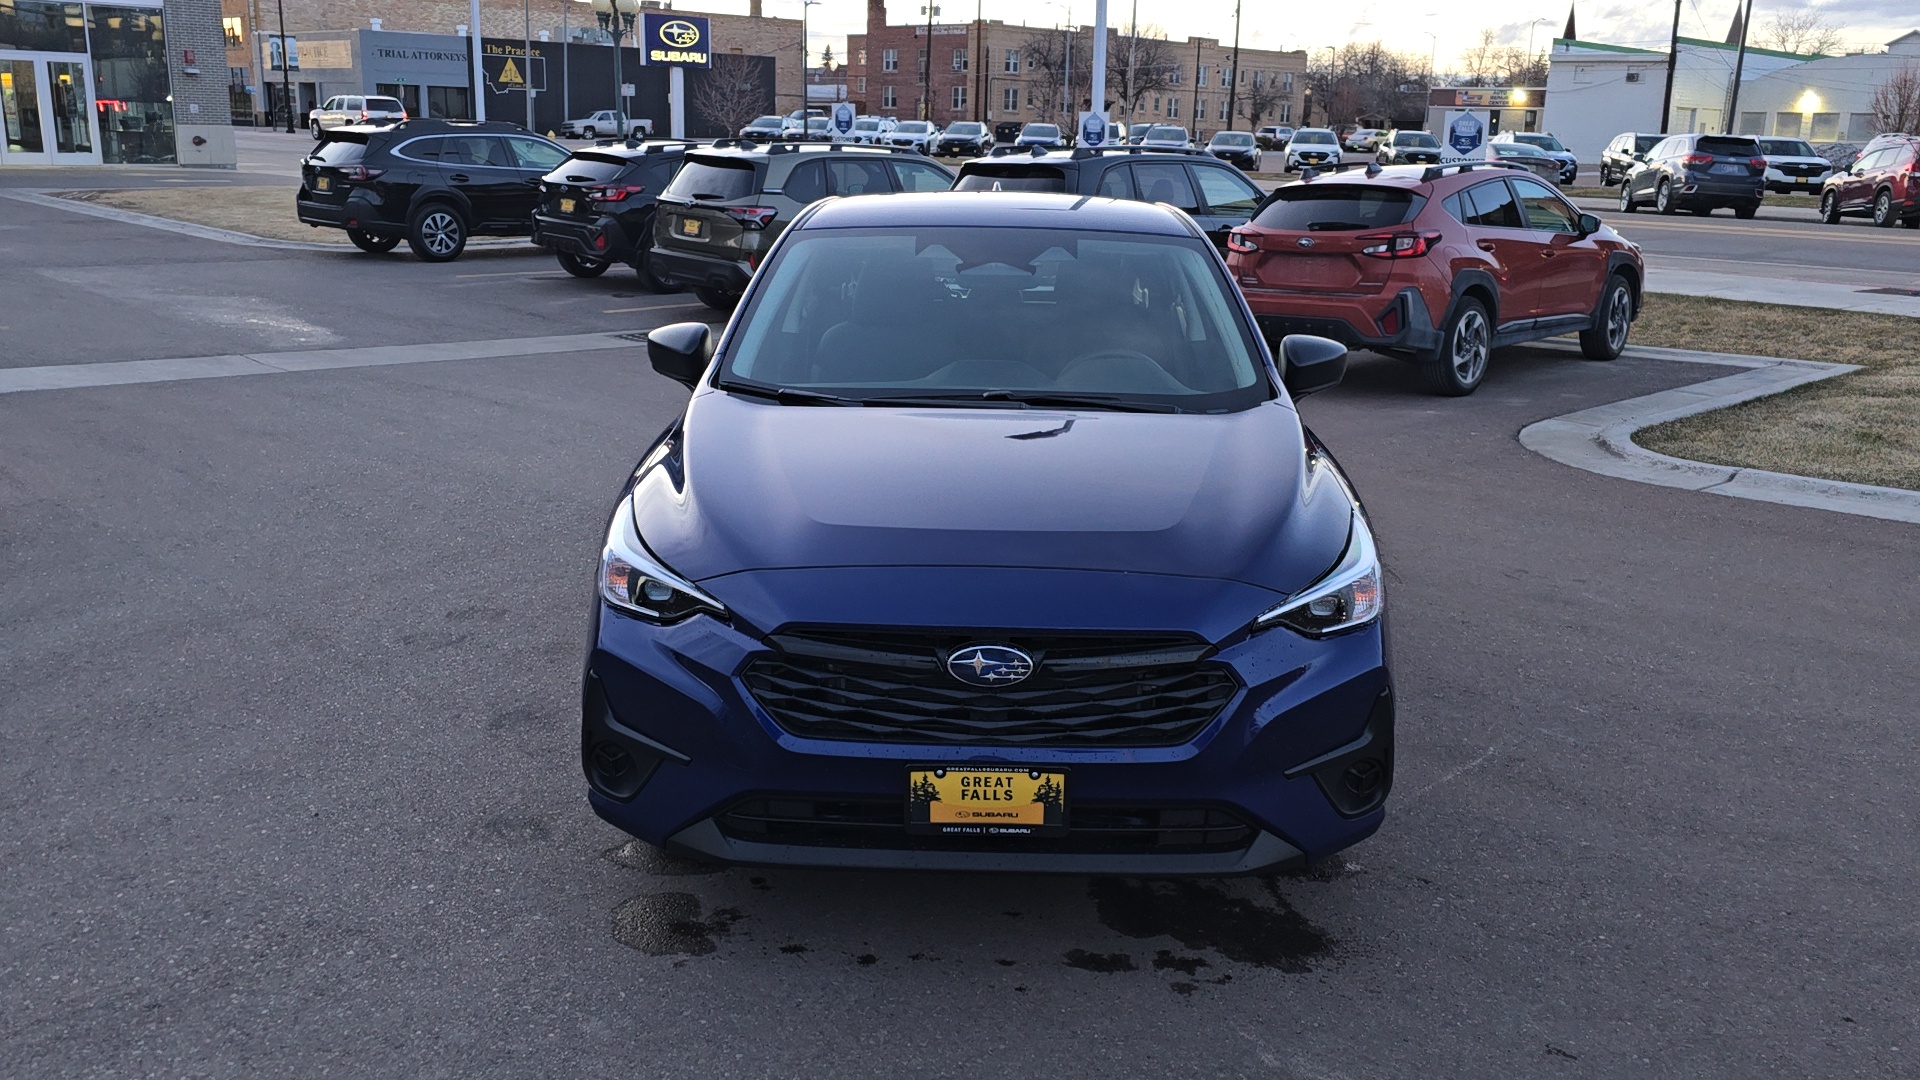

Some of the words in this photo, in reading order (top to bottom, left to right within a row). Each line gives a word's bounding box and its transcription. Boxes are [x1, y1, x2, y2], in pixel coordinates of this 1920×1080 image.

[377, 48, 409, 59] TRIAL
[411, 50, 467, 62] ATTORNEYS
[485, 44, 503, 54] The
[505, 45, 540, 57] Pracce
[650, 50, 707, 63] SUBARU
[961, 776, 1014, 788] GREAT
[961, 789, 1013, 801] FALLS
